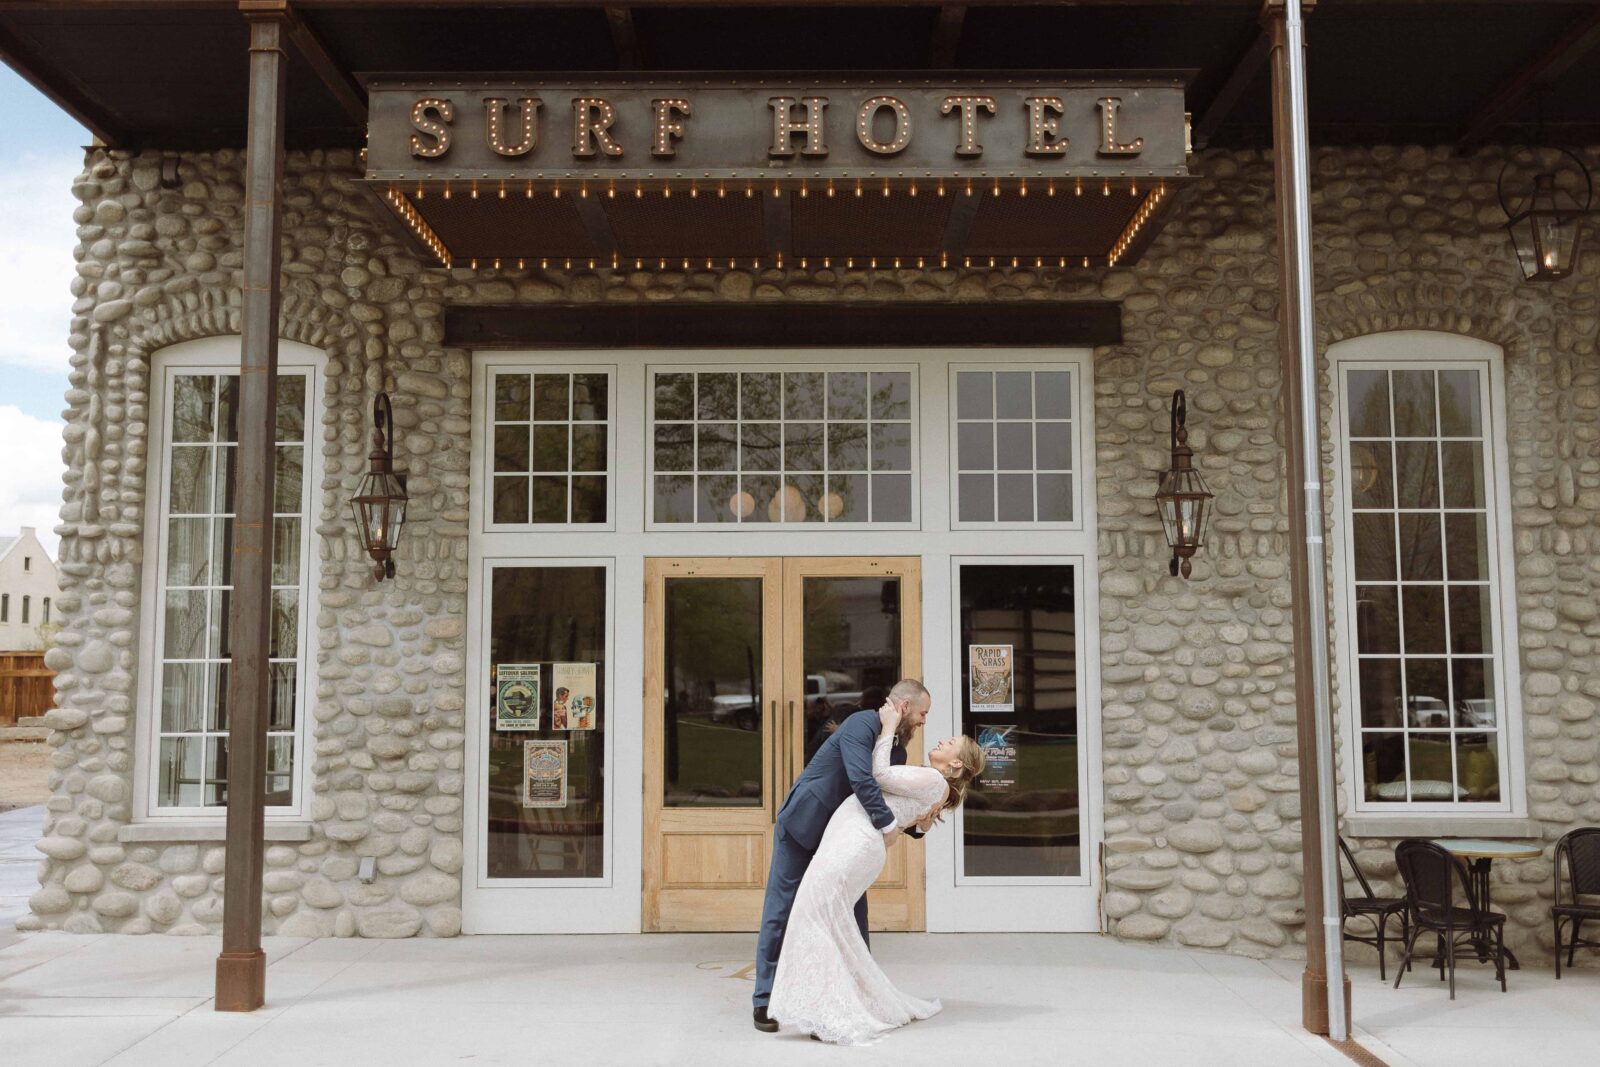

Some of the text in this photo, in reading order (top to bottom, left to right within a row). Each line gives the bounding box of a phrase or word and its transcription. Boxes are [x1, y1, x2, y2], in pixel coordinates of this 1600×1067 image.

[410, 96, 1144, 158] SURF HOTEL
[976, 647, 1001, 660] RAPID
[982, 657, 1006, 667] GRASS
